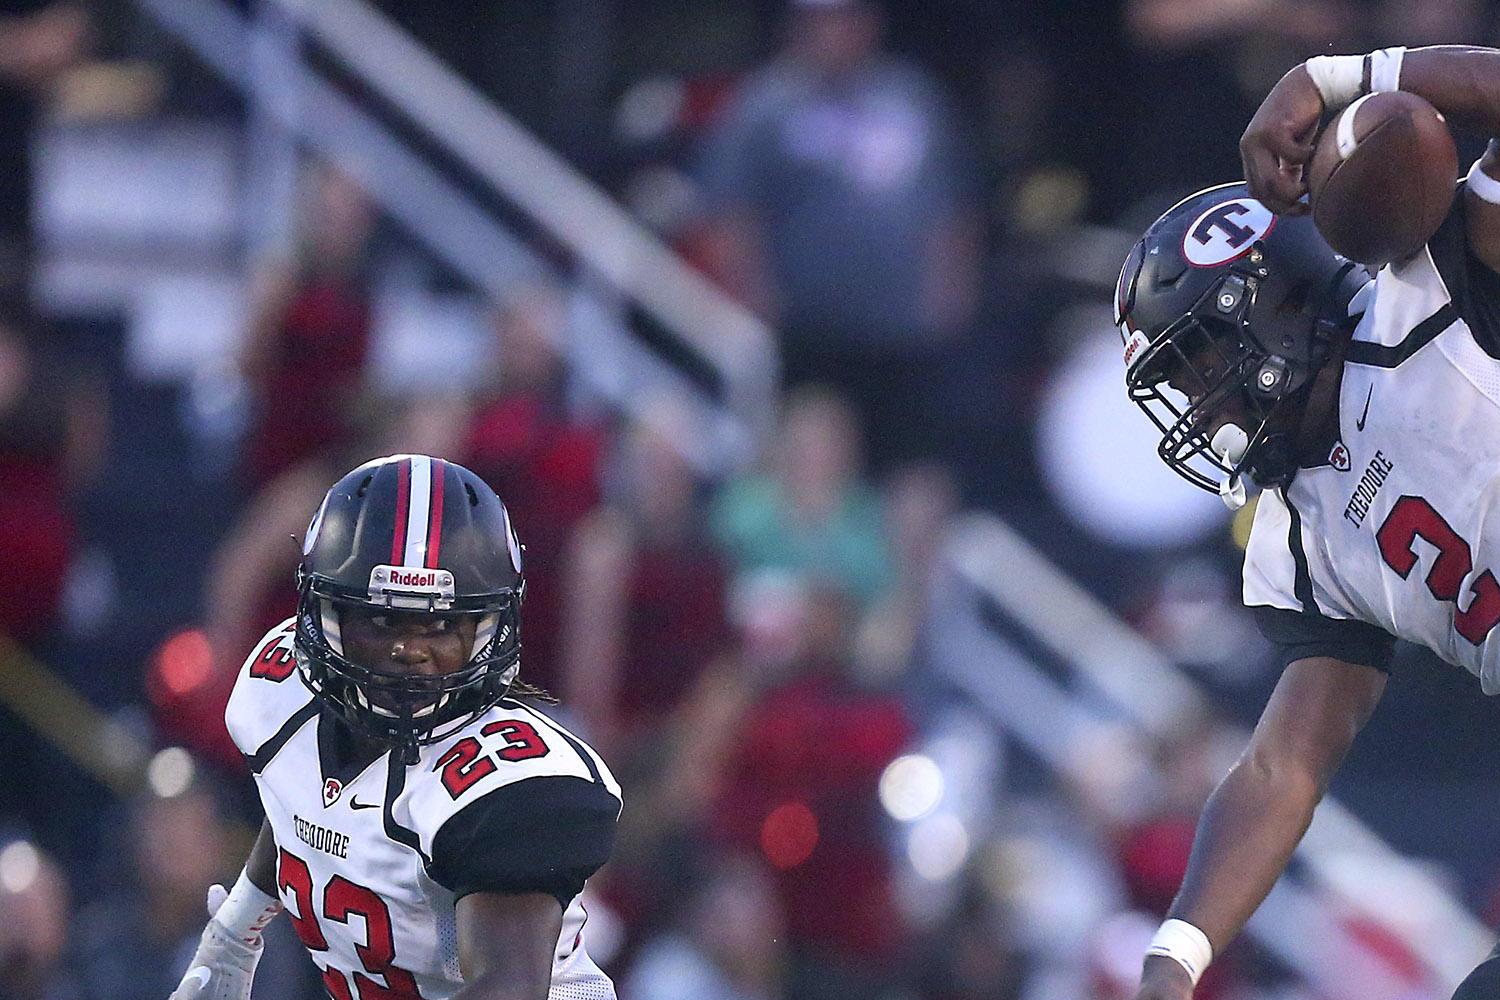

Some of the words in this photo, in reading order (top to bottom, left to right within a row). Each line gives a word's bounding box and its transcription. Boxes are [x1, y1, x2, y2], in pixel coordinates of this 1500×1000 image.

[1192, 203, 1256, 250] T
[1331, 446, 1347, 467] T
[1343, 450, 1394, 529] THEODORE
[390, 570, 435, 586] Riddell
[432, 719, 551, 802] 23
[326, 780, 340, 799] T
[293, 814, 350, 859] THEODORE
